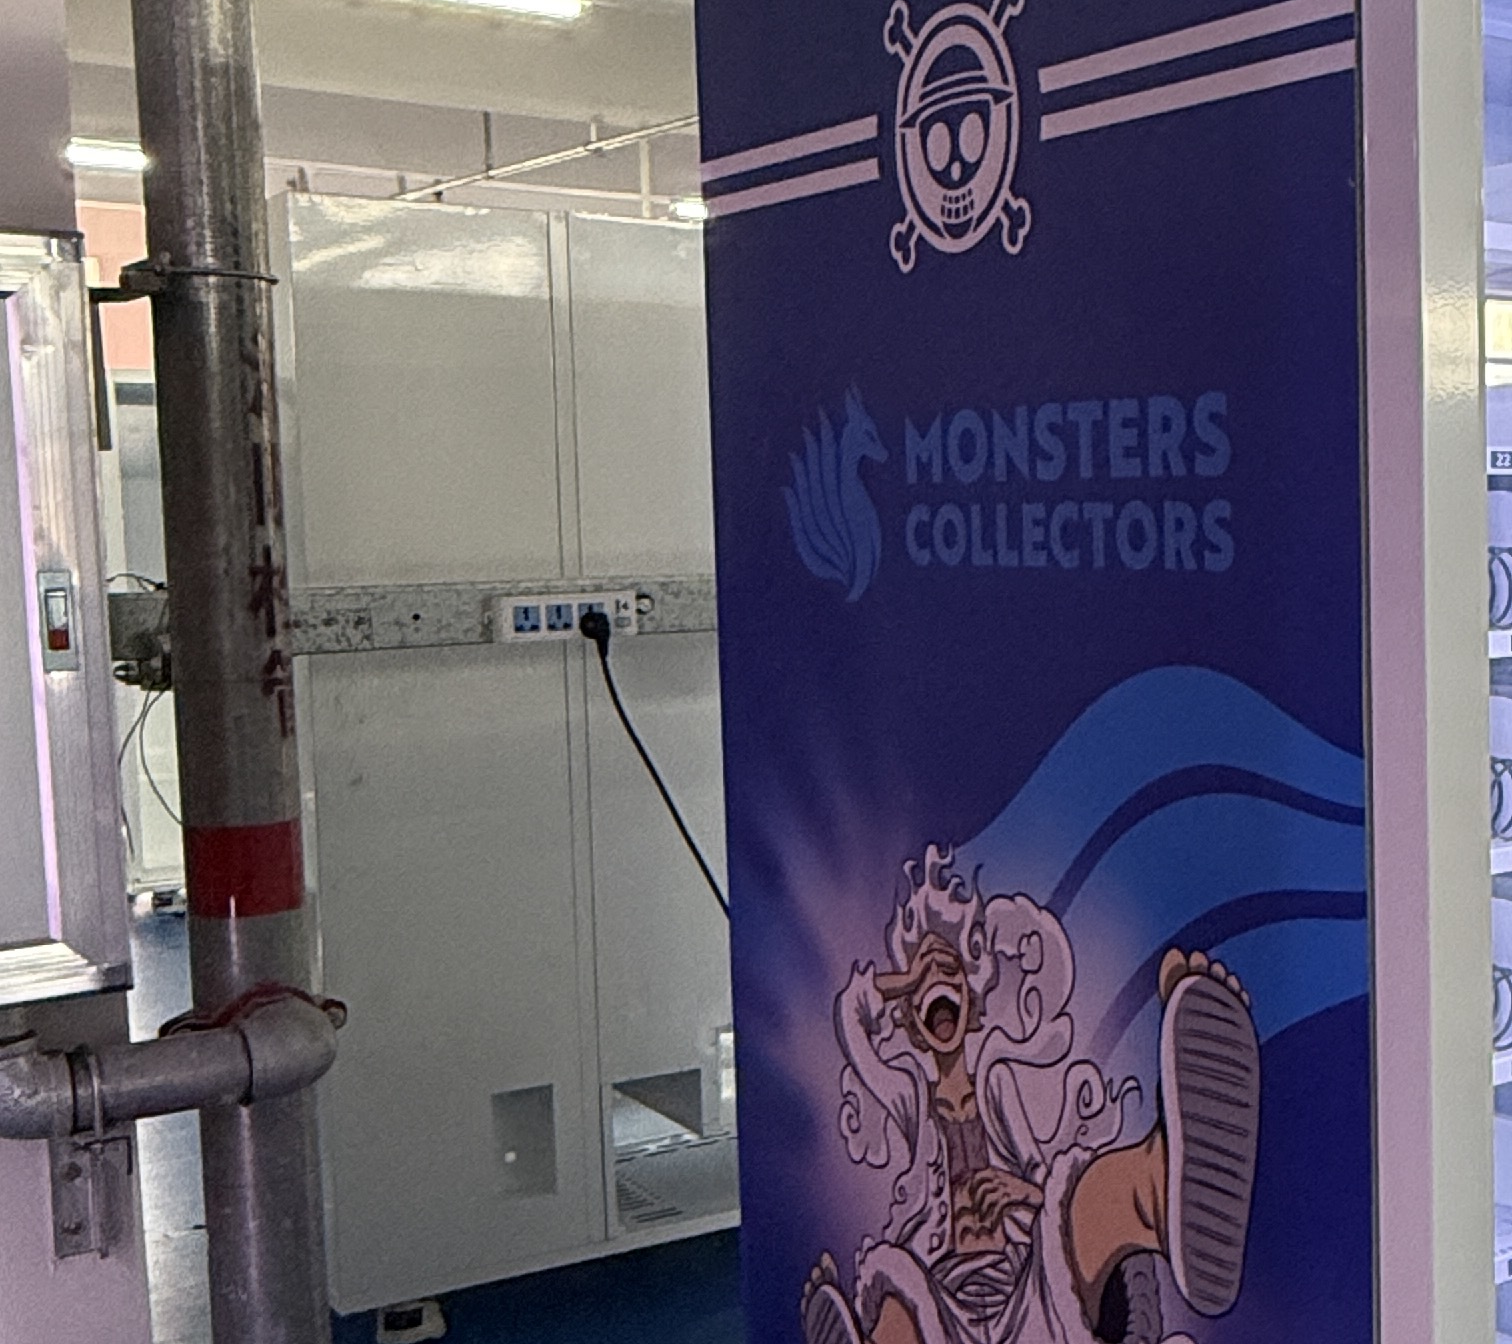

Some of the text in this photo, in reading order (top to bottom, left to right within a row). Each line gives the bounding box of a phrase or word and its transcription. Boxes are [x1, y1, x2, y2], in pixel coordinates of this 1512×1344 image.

[904, 390, 1234, 485] MONSTERS
[1495, 452, 1512, 467] 22
[904, 498, 1236, 573] COLLECTORS
